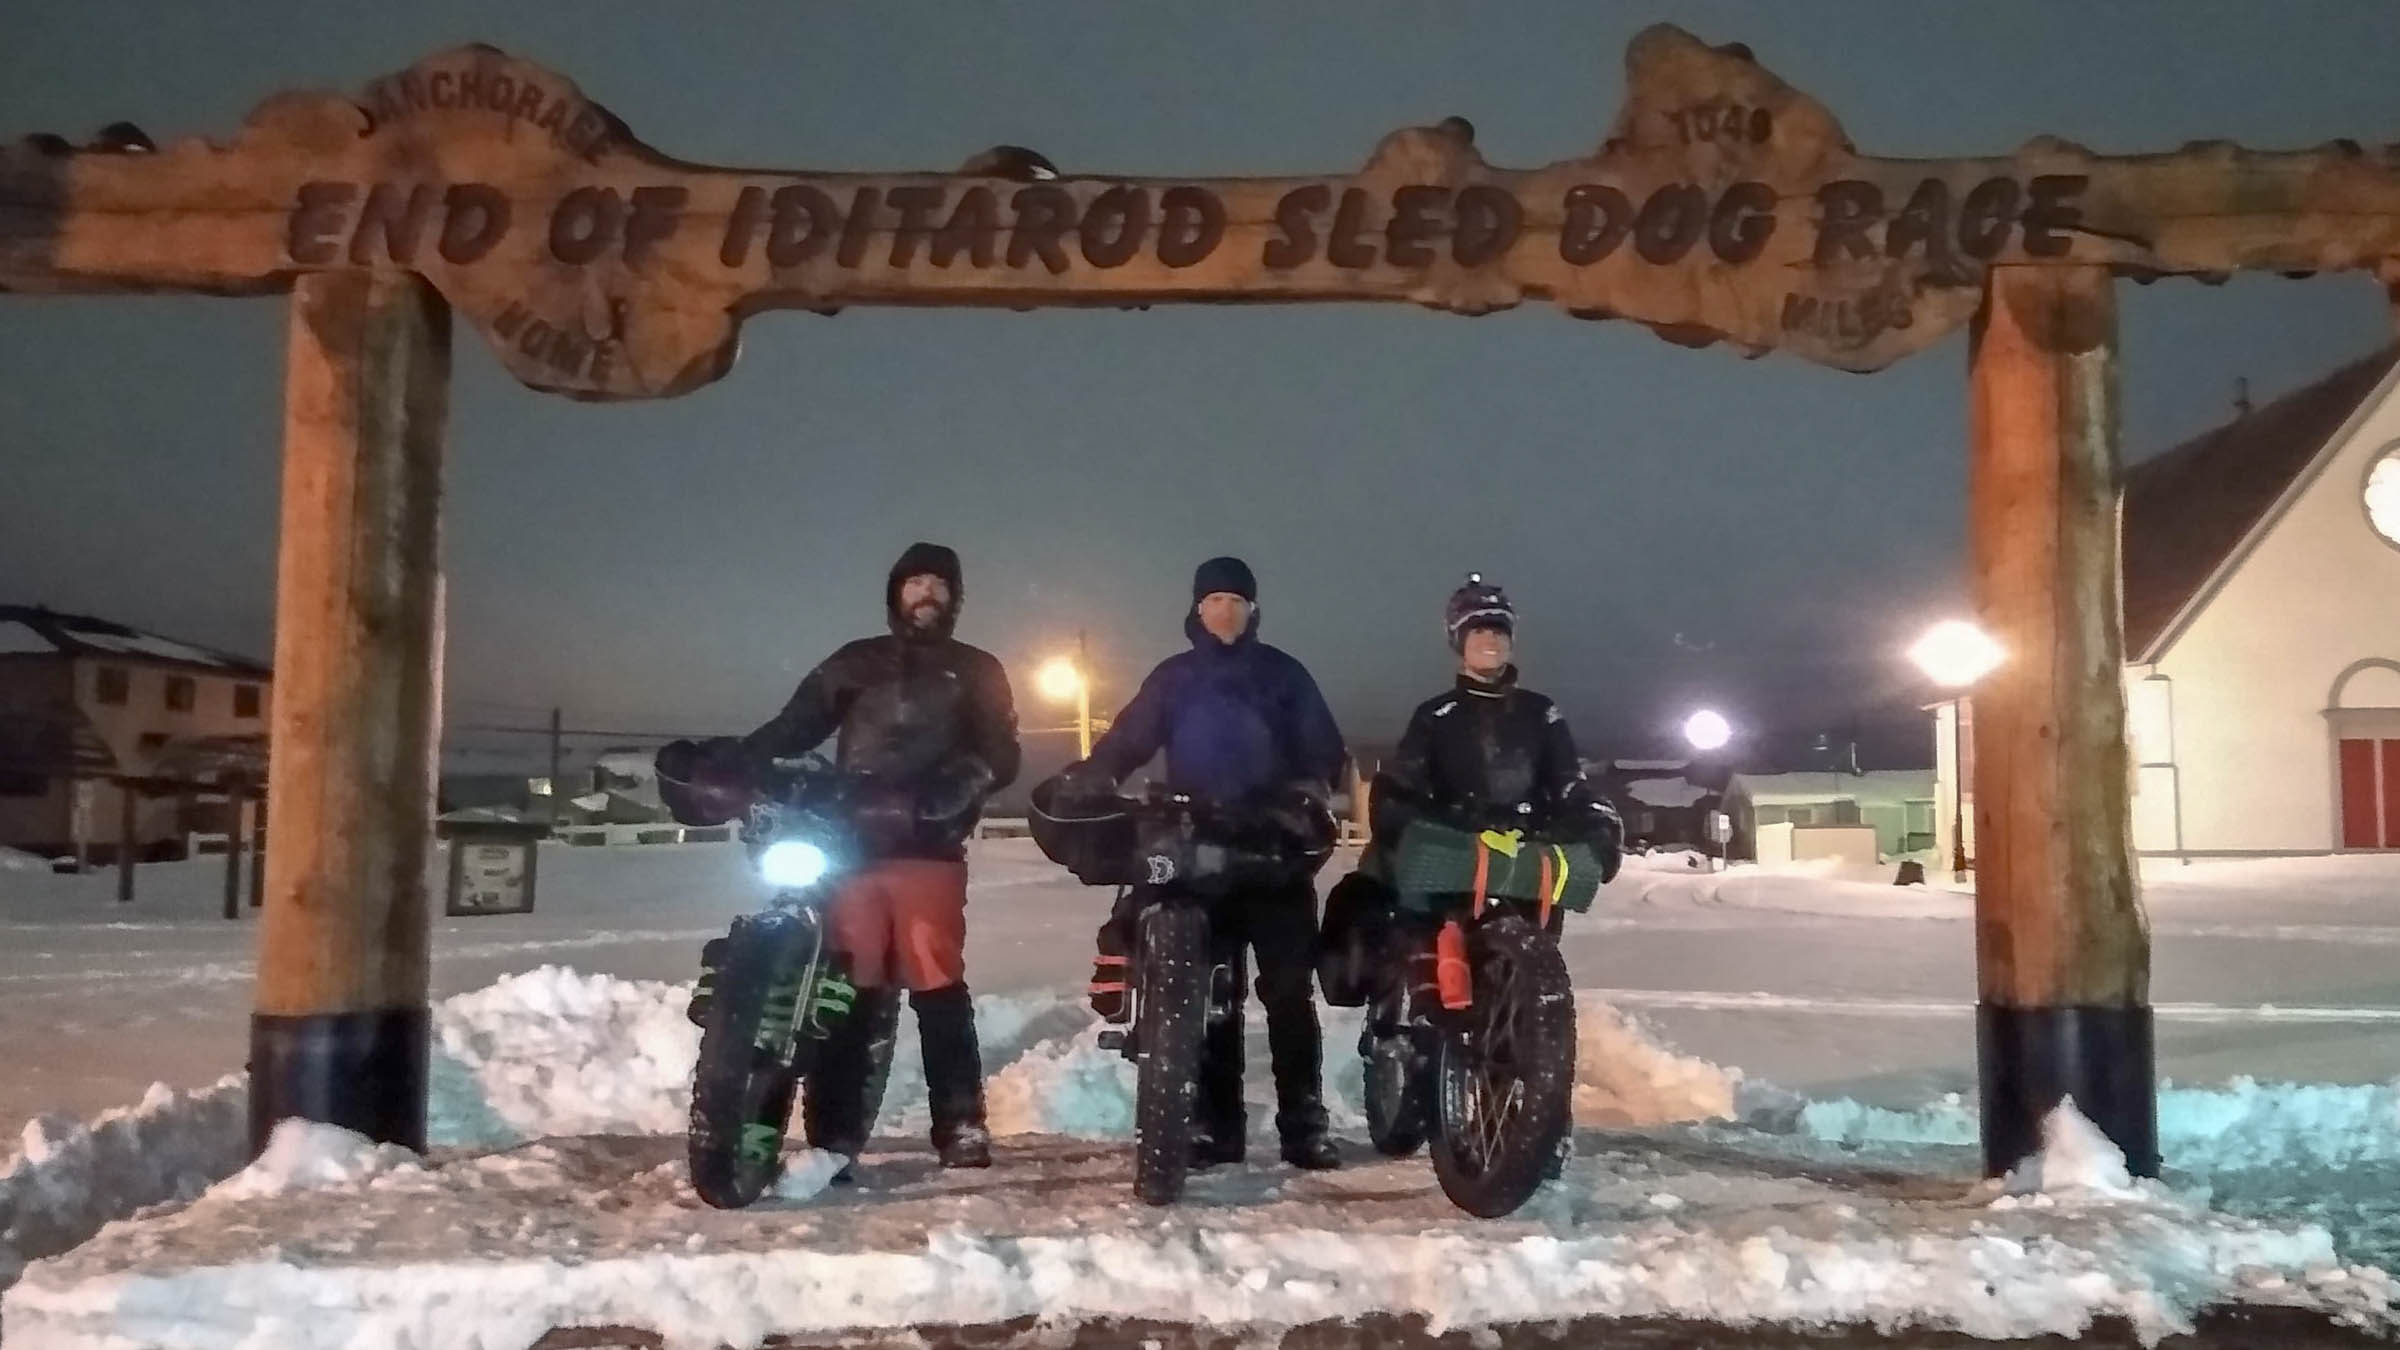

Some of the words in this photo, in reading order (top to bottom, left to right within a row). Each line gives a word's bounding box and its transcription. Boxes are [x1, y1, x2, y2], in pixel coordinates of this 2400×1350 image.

[287, 180, 512, 266] END
[548, 184, 690, 267] OF
[719, 185, 1228, 275] IDITAROD
[1261, 184, 1525, 269] SLED
[1558, 181, 1778, 266] DOG
[1812, 174, 2090, 264] RACE
